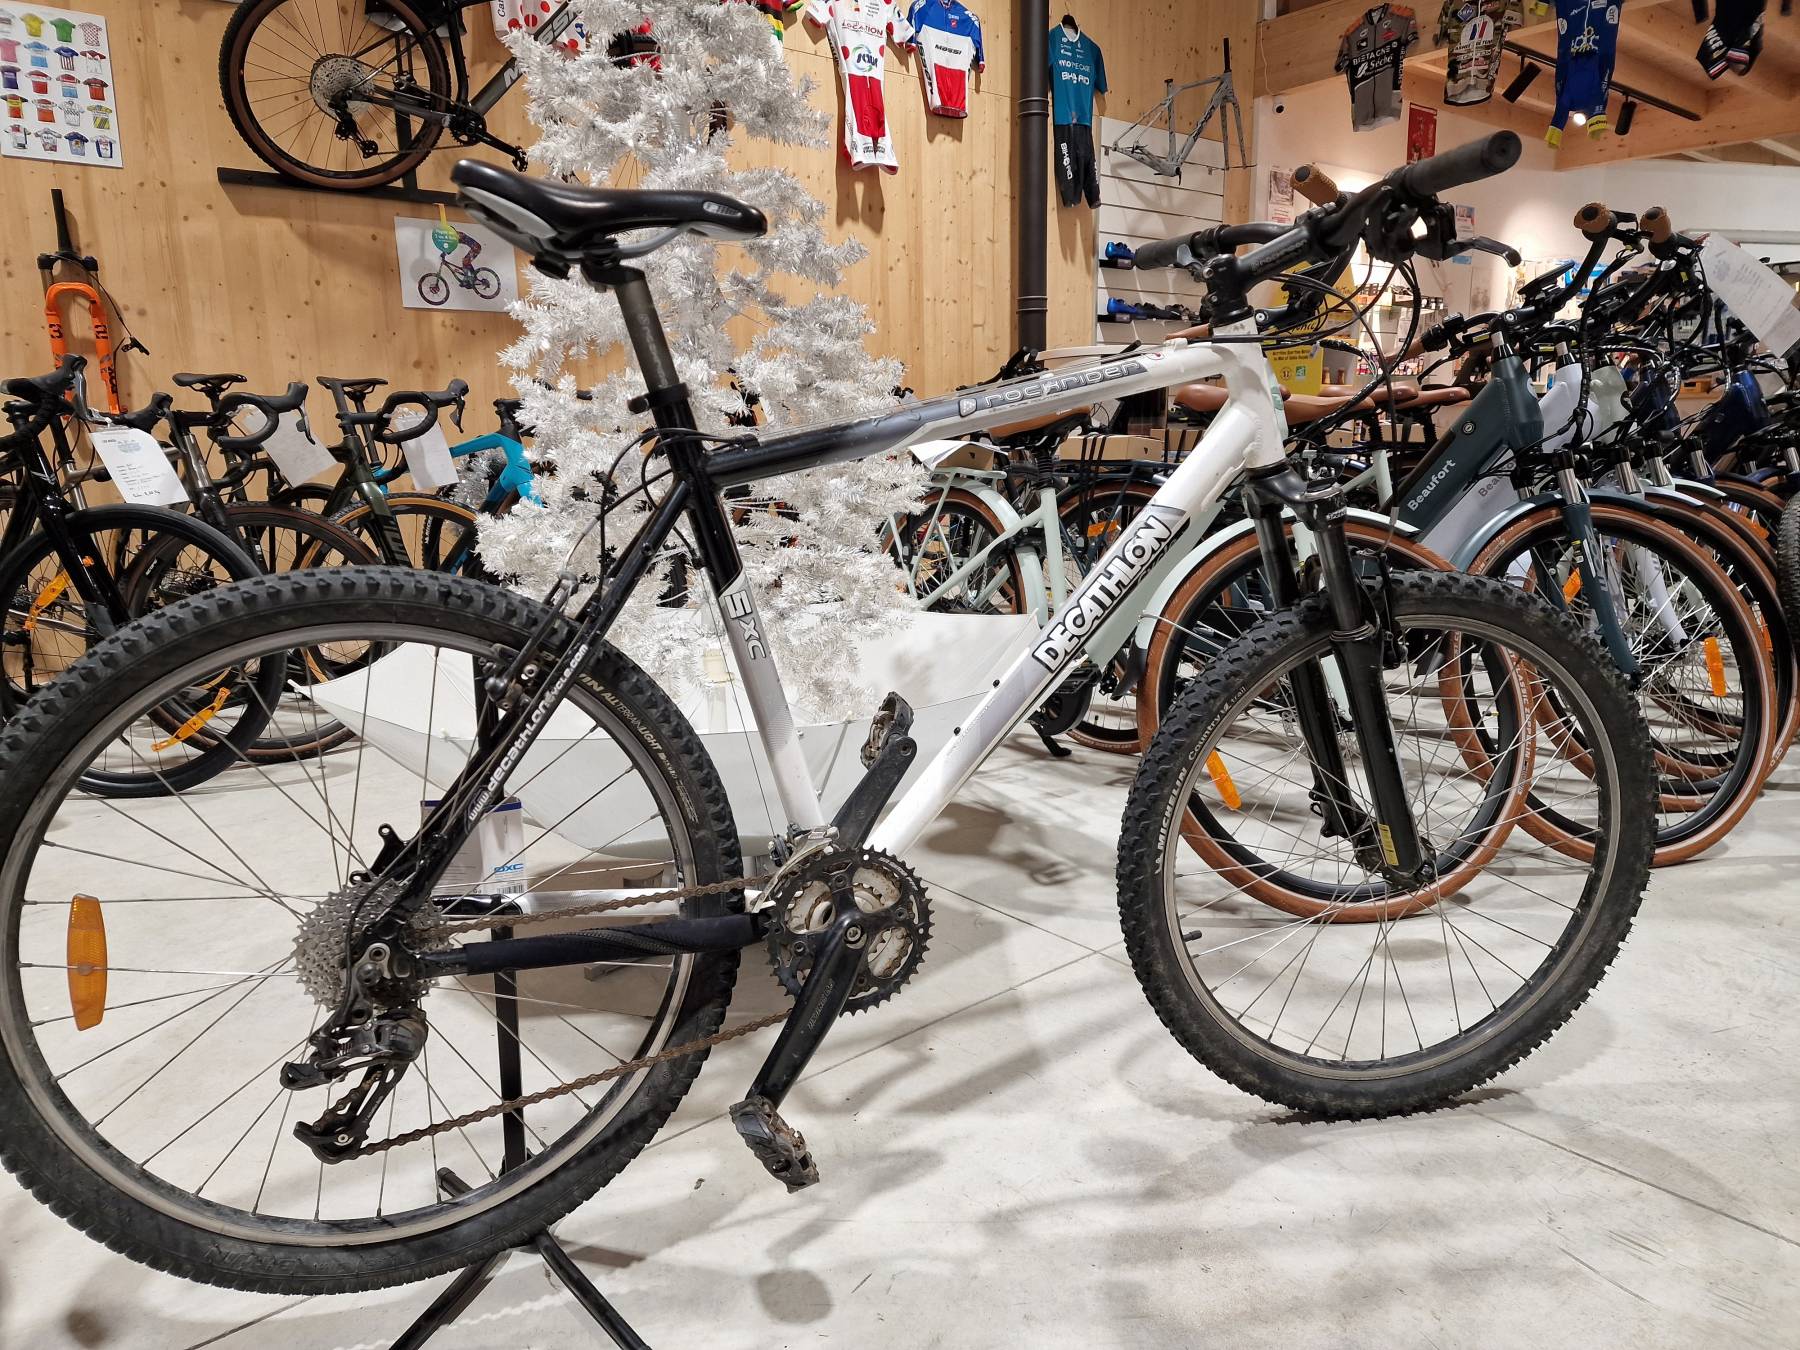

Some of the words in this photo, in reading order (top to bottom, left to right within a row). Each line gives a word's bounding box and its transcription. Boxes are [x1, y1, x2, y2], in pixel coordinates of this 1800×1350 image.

[1406, 458, 1457, 512] Beaufort
[1031, 514, 1172, 673] DECATHLON
[1158, 766, 1188, 851] MICHELIN
[1189, 712, 1222, 761] Country
